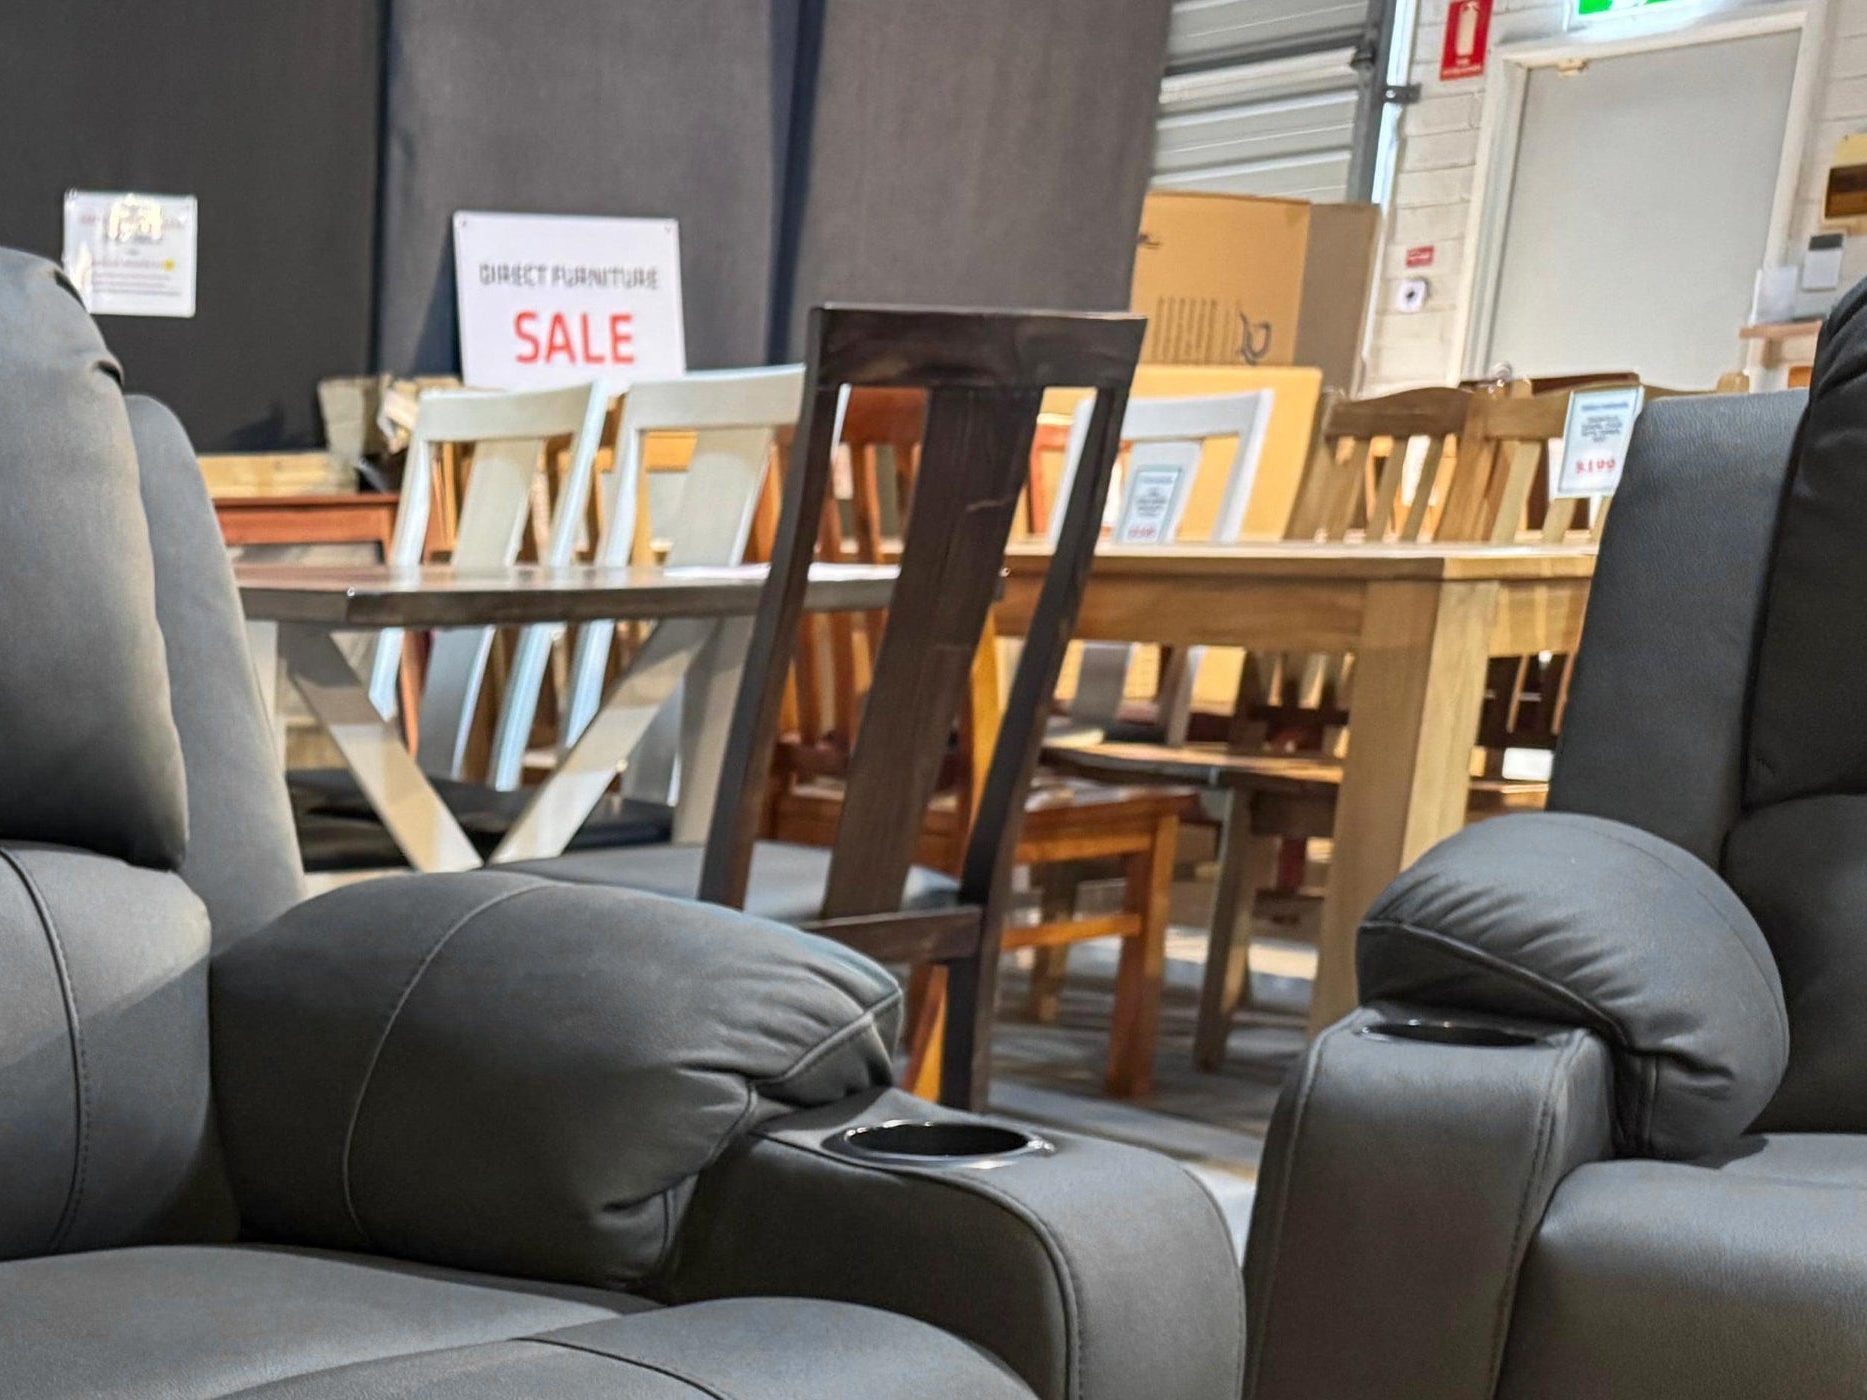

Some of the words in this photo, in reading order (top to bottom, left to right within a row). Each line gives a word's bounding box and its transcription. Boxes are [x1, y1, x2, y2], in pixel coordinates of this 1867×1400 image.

[479, 262, 548, 287] DIRECT
[551, 263, 660, 290] FURNITURE
[513, 309, 636, 365] SALE
